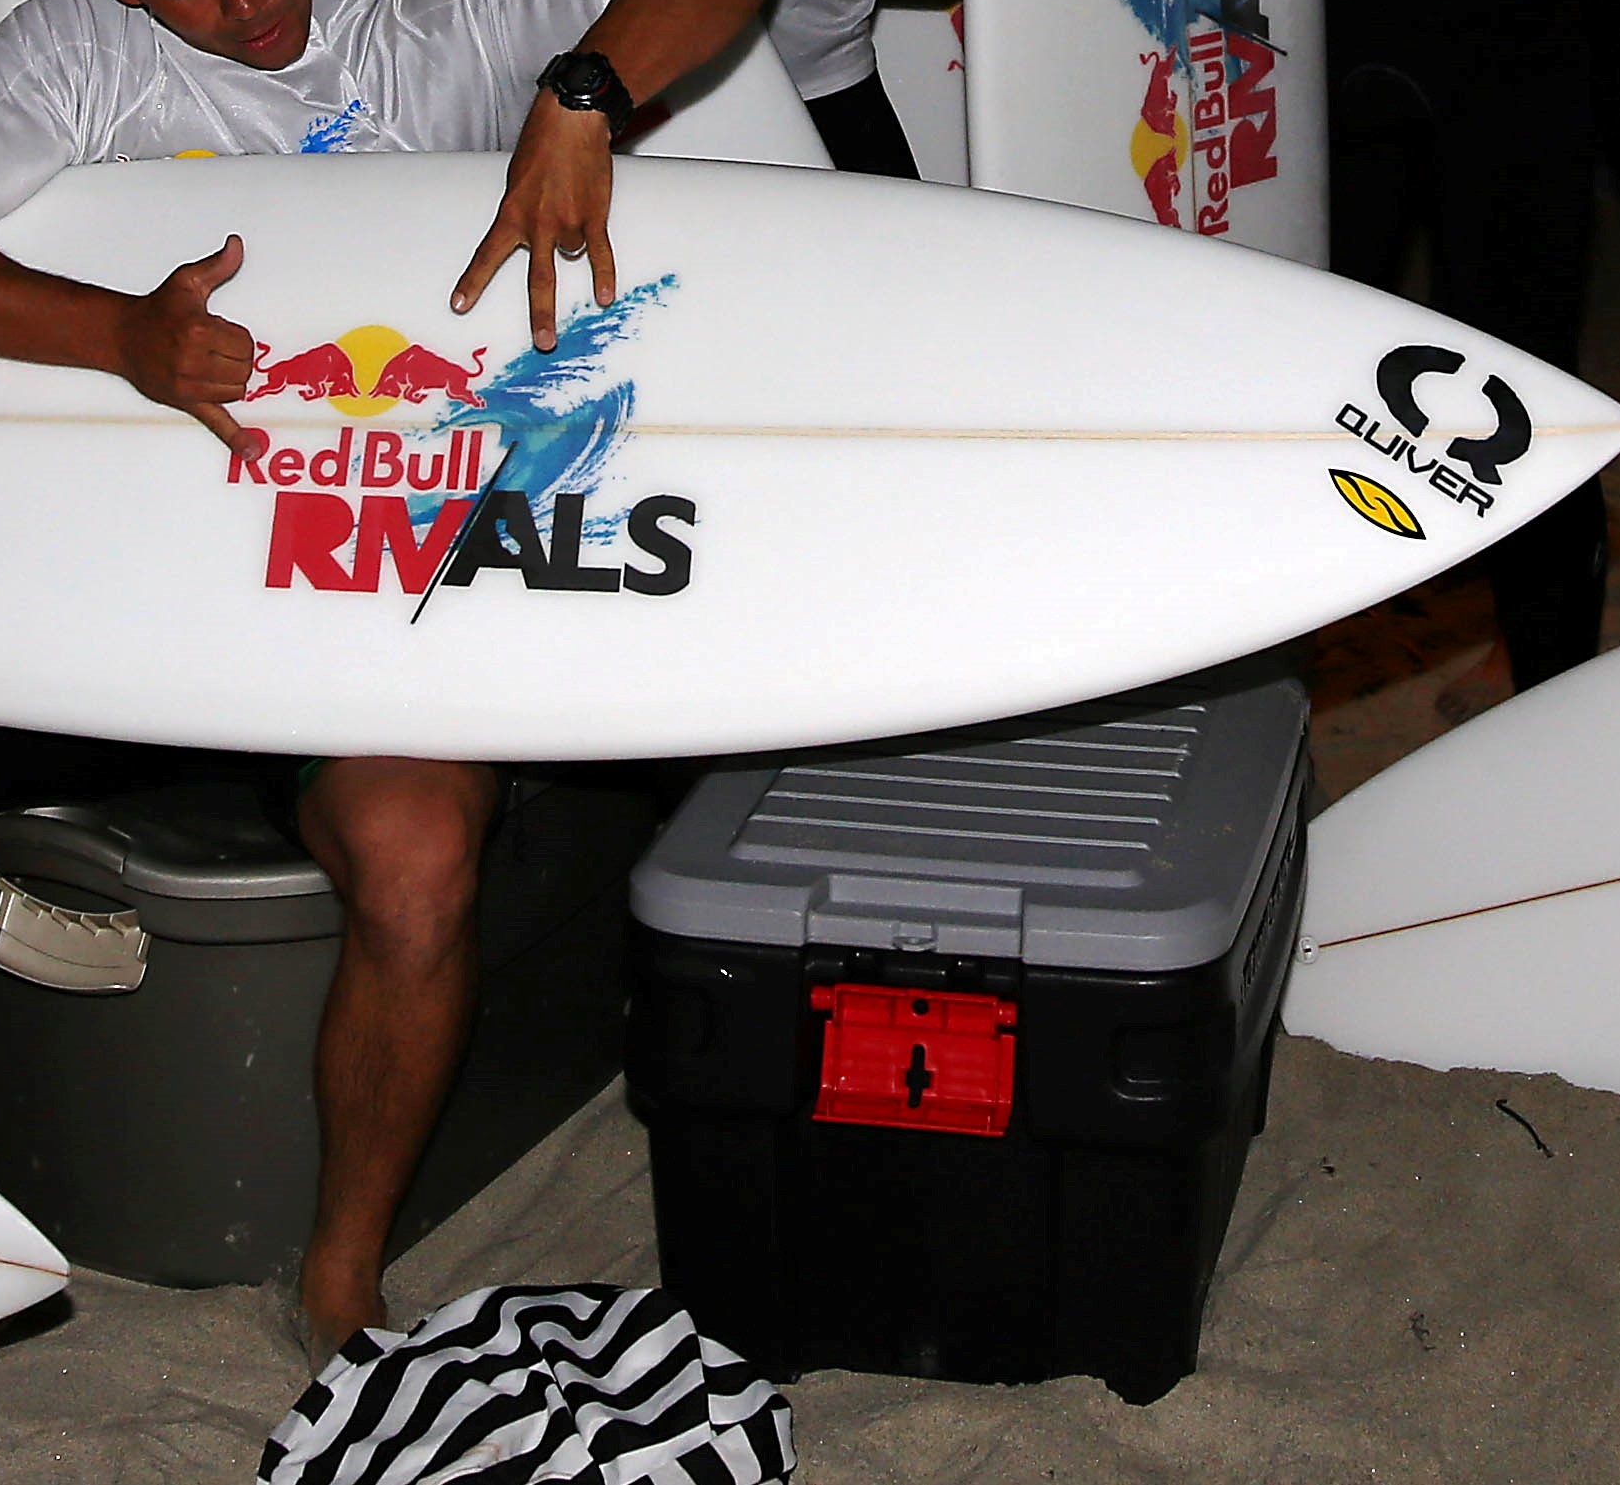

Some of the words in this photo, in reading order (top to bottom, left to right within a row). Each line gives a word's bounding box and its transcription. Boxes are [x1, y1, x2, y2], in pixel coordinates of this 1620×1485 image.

[1188, 28, 1229, 131] Bull
[1192, 135, 1230, 236] Red
[226, 426, 354, 488] Red
[360, 428, 484, 492] Bull
[1334, 402, 1496, 519] QUIVER
[264, 478, 698, 602] RIVALS
